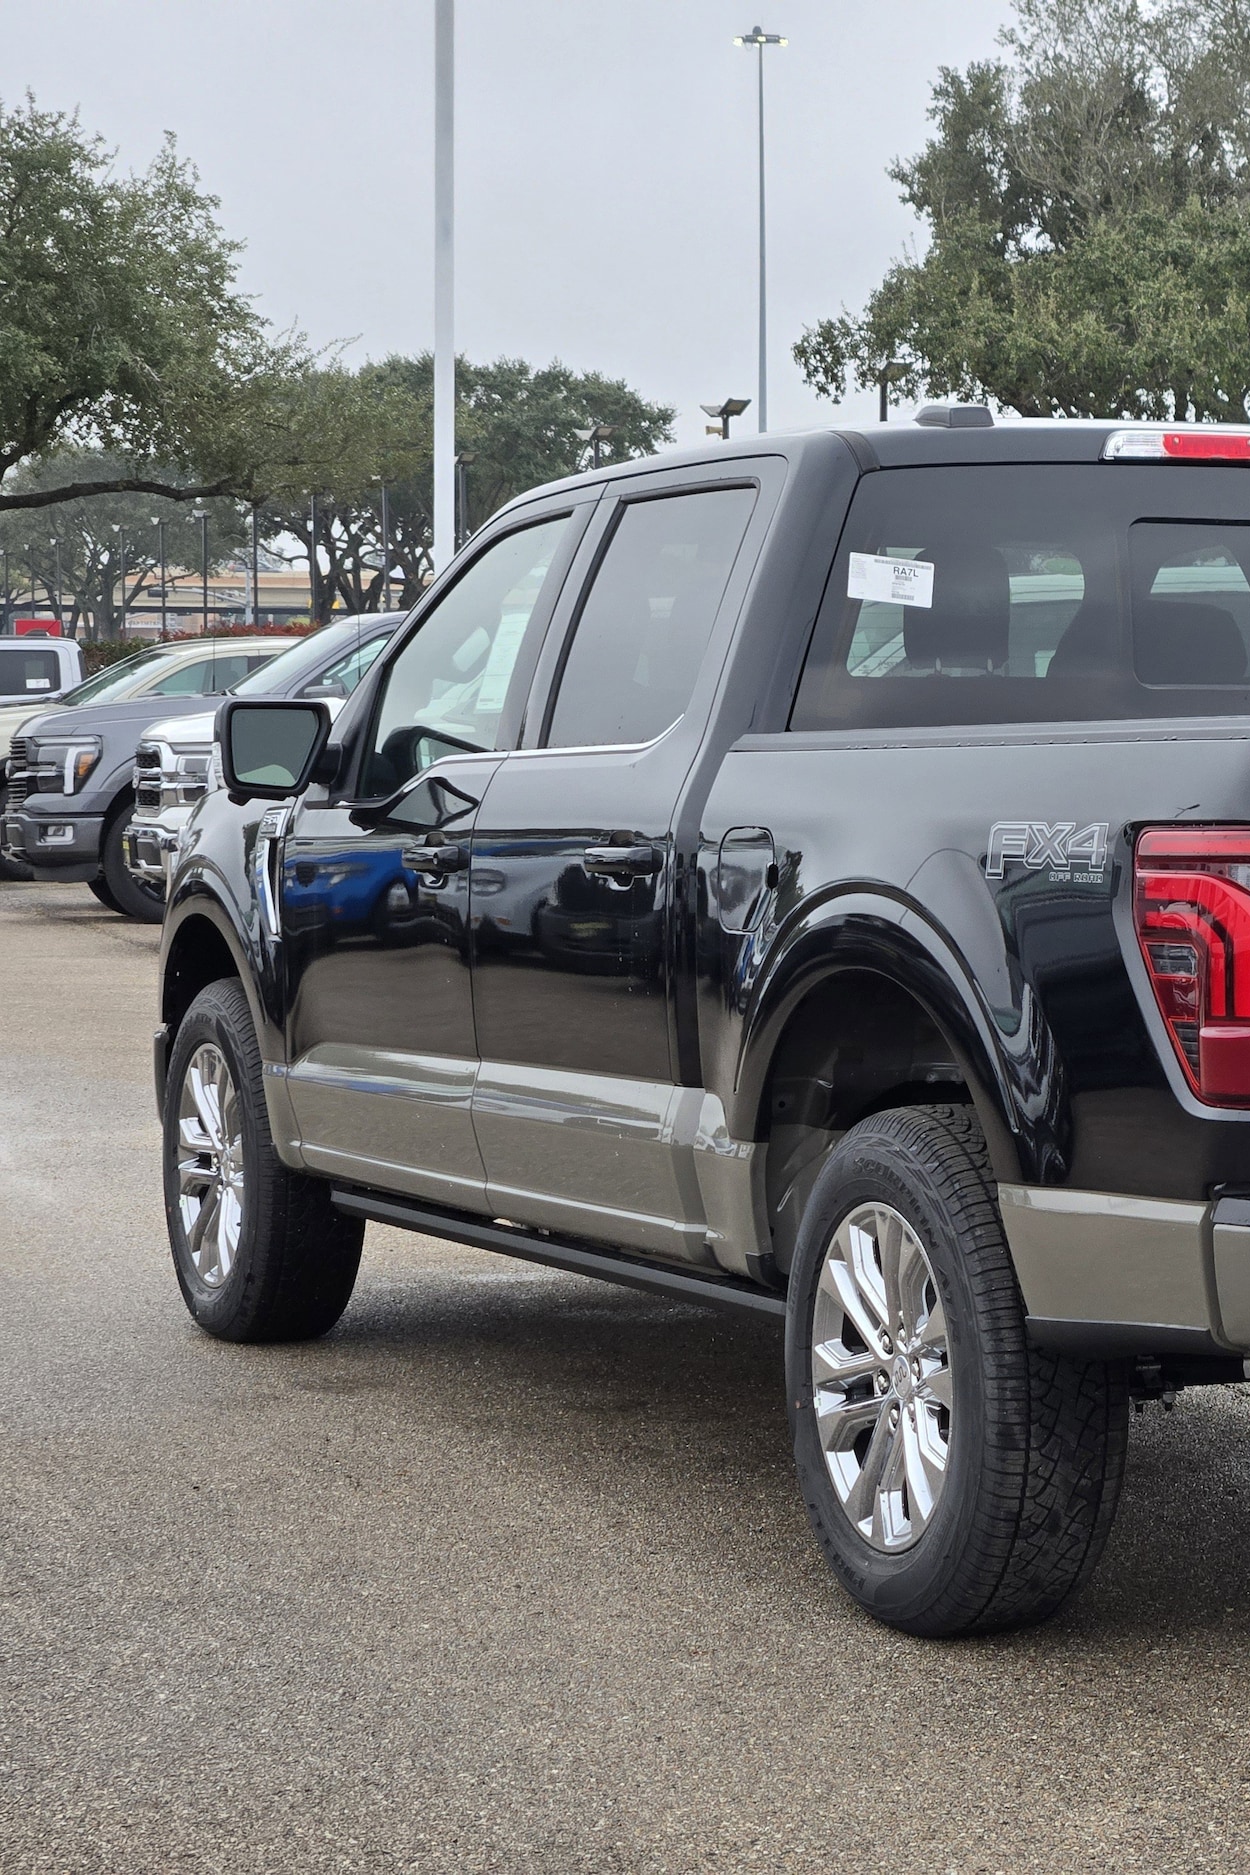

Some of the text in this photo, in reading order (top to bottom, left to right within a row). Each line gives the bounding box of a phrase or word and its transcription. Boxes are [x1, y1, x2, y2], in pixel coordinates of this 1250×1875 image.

[893, 566, 919, 577] RA7L
[985, 821, 1109, 879] FX4
[1049, 871, 1103, 883] OFF ROAD
